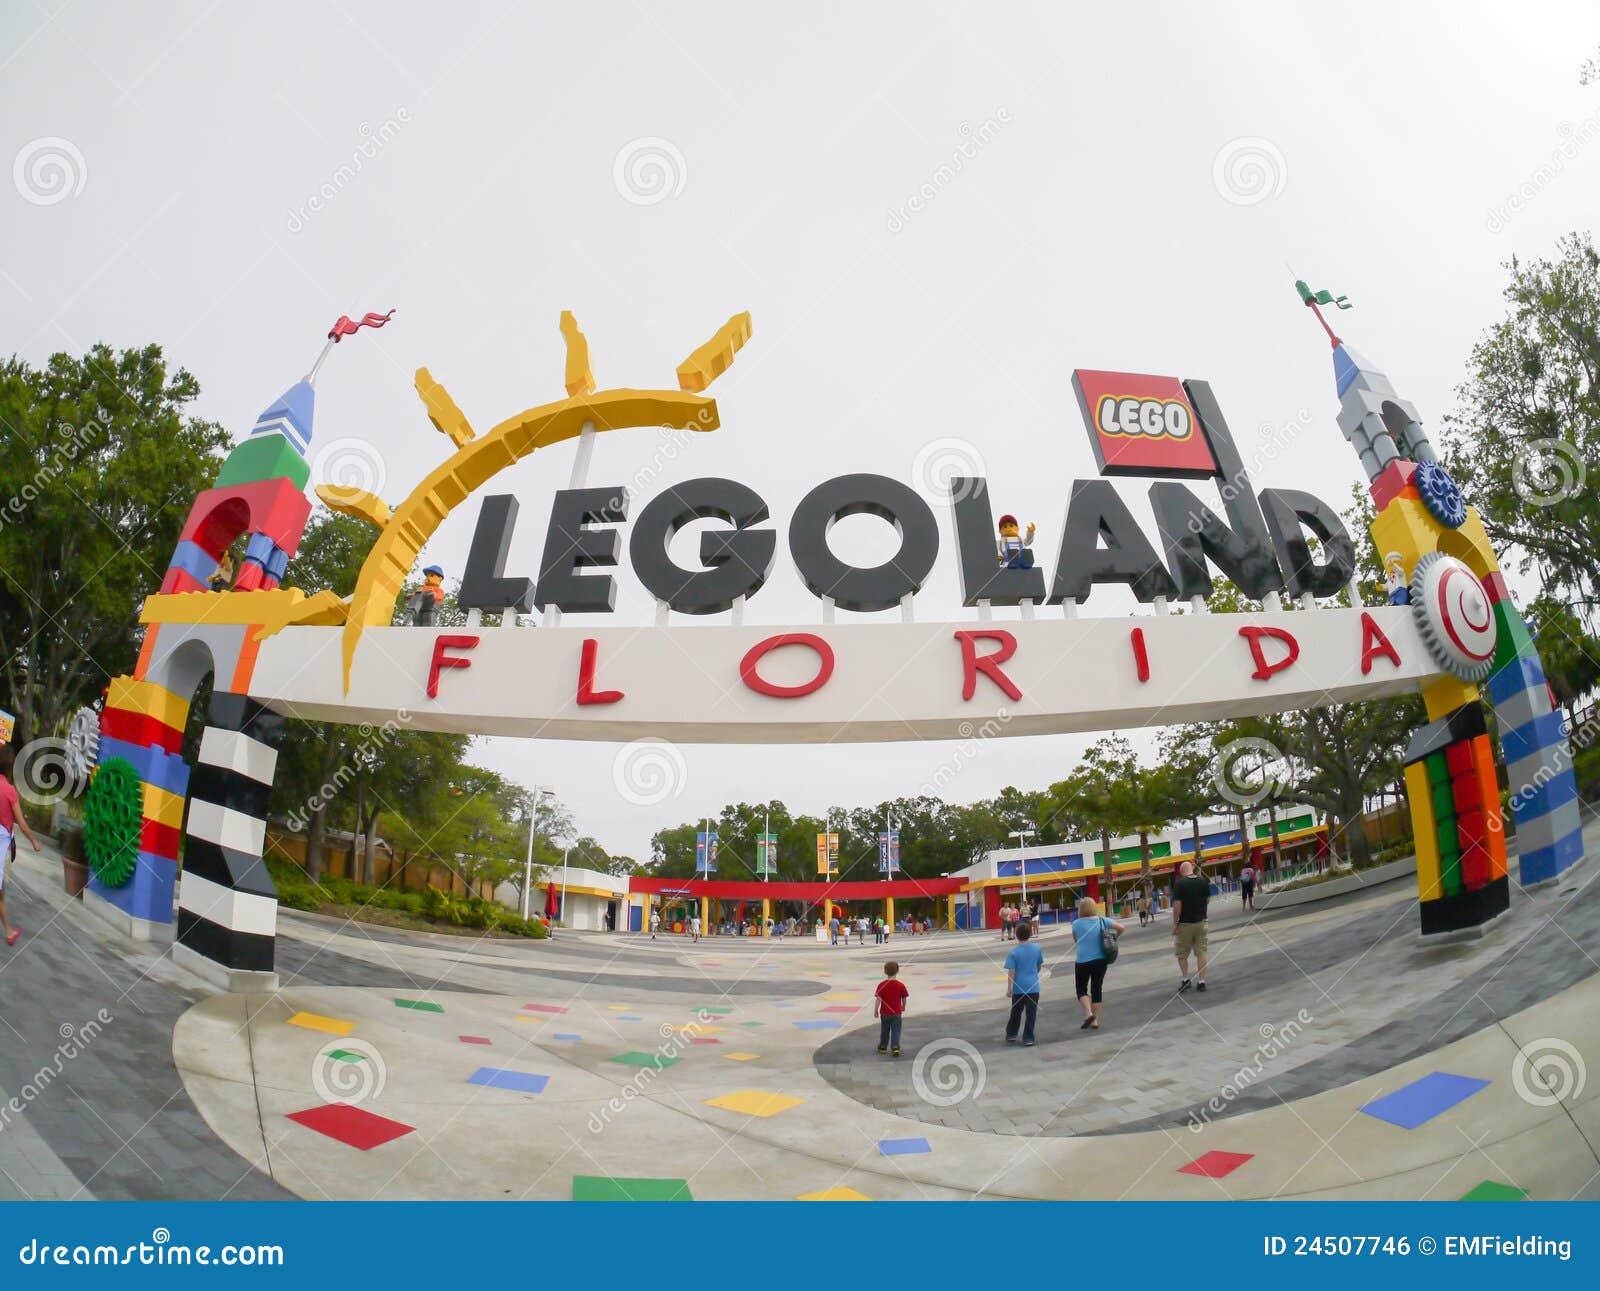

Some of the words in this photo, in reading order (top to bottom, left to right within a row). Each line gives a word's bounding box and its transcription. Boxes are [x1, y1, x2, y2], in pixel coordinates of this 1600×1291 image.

[1101, 398, 1188, 437] LEGO
[459, 379, 1356, 616] LEGOLAND
[426, 611, 1402, 705] FLORIDA
